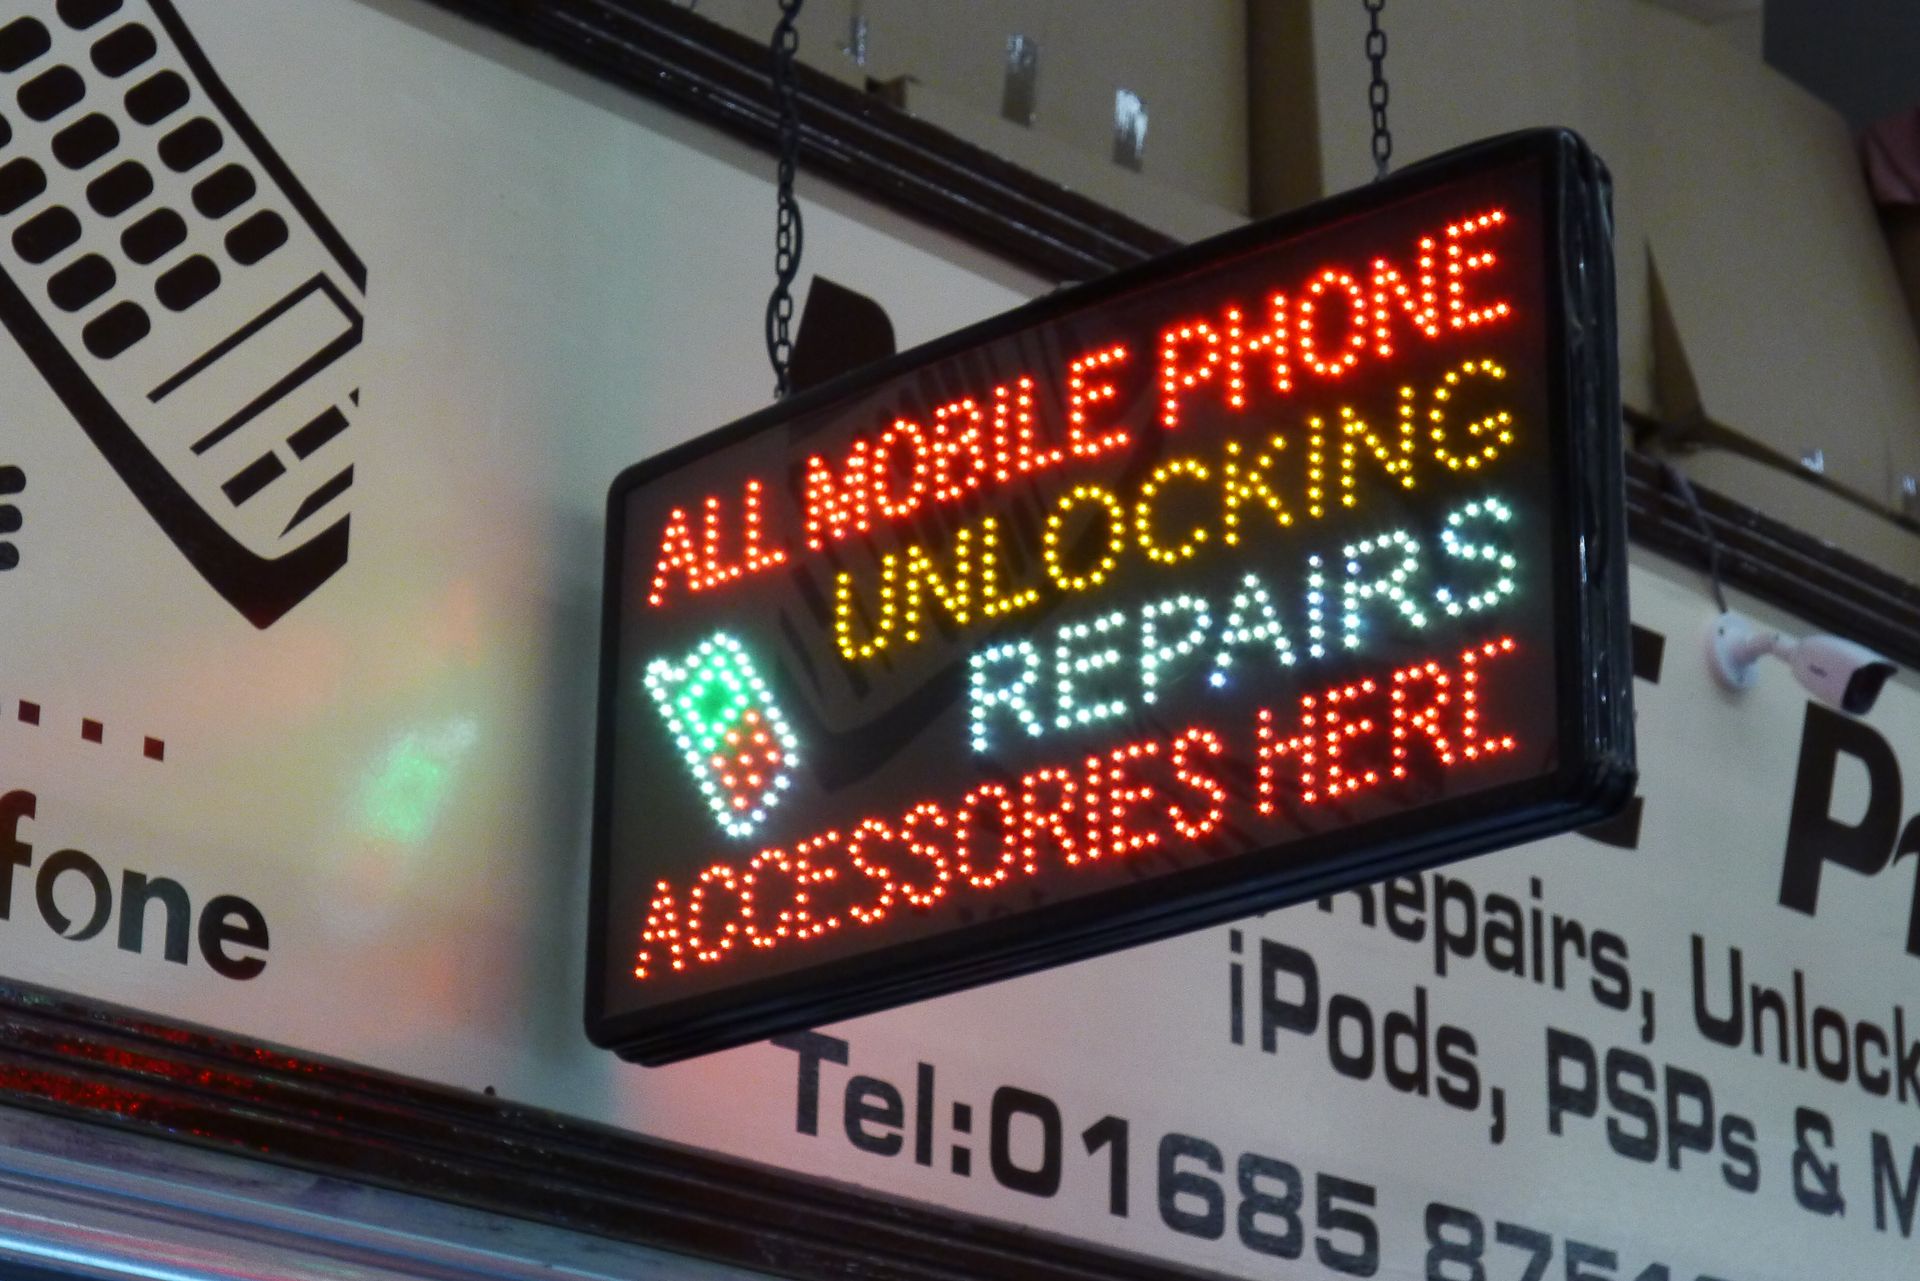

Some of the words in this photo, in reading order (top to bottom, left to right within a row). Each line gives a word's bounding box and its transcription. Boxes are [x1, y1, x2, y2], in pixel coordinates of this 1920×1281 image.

[648, 479, 788, 607] ALL
[806, 345, 1131, 551] MOBILE
[1162, 208, 1512, 428] PHONE
[834, 360, 1514, 661] UNLOCKING
[968, 495, 1520, 753] REPAIRS
[632, 726, 1228, 980] ACCESSORIES
[1230, 929, 1506, 1144] iPods,
[1546, 1026, 1760, 1194] PSPs
[1793, 1105, 1846, 1218] &
